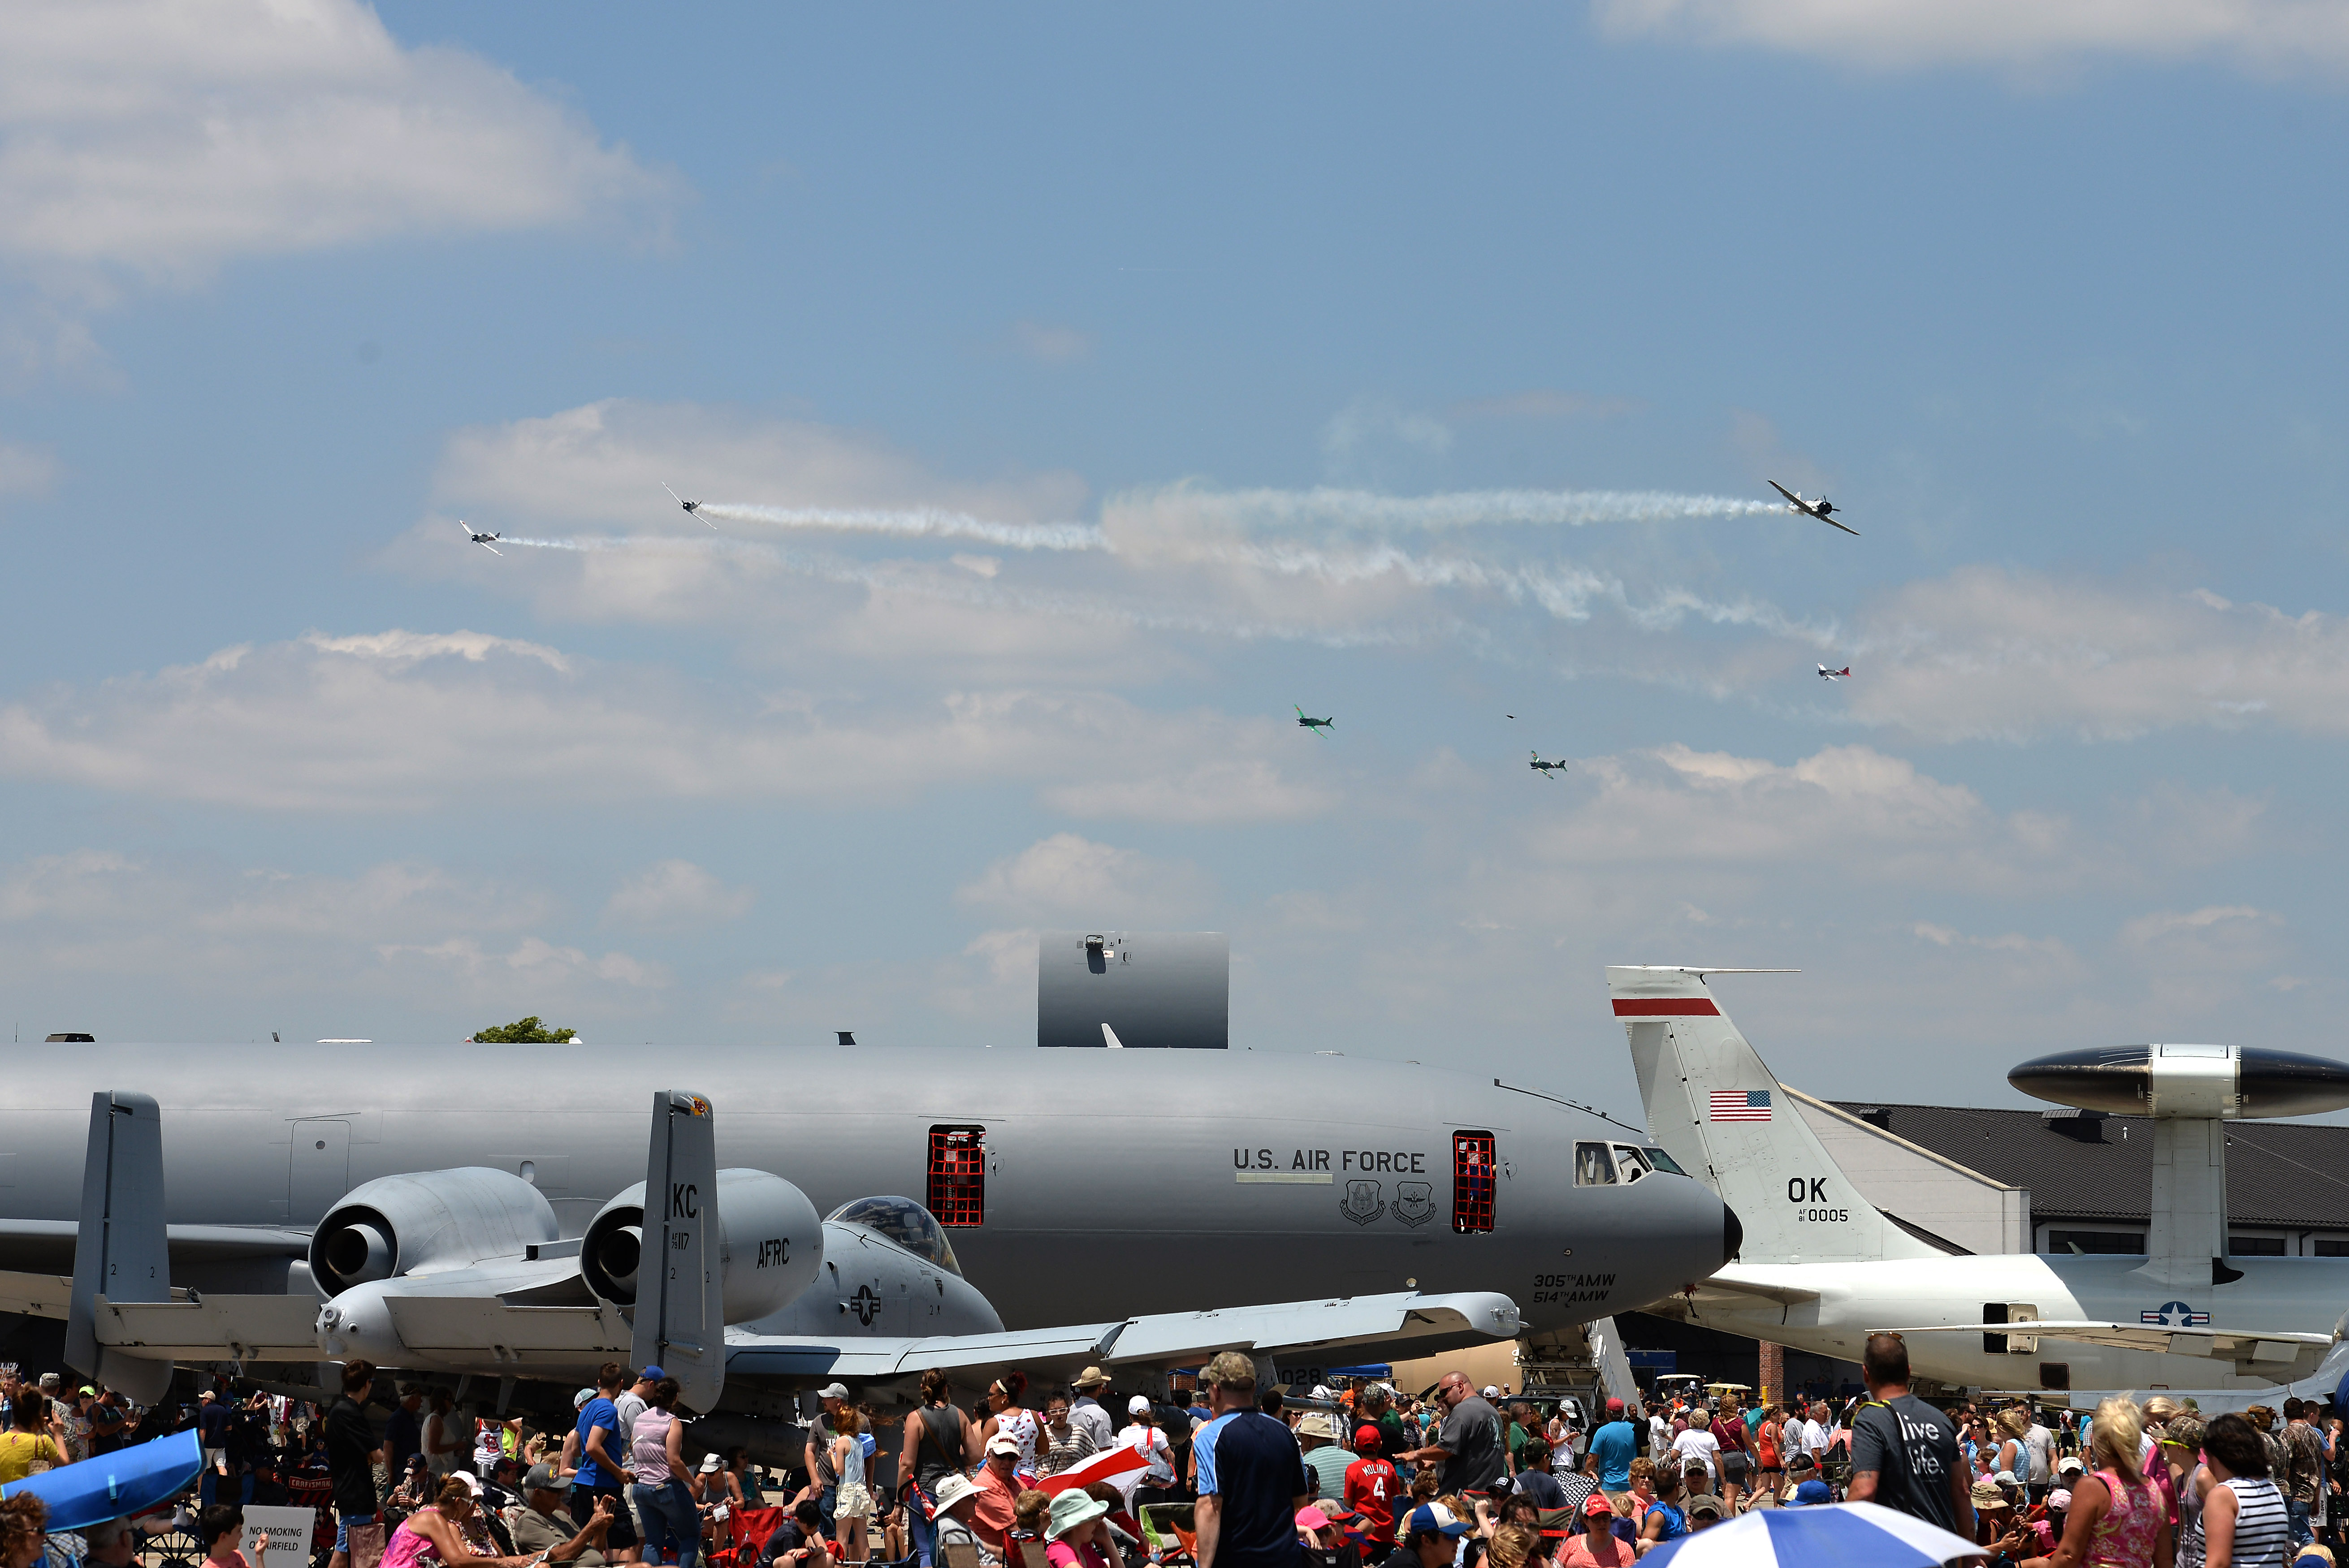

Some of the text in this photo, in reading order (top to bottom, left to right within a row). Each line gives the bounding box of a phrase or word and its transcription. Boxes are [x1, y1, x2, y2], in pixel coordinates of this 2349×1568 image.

[1234, 1149, 1425, 1173] U.S. AIR FORCE
[1788, 1177, 1828, 1202] OK
[673, 1183, 697, 1218] KC
[1349, 1212, 1363, 1223] FORCE
[1363, 1208, 1383, 1222] RESERVE
[1397, 1214, 1415, 1225] MOBILITY
[1417, 1210, 1433, 1223] COMMAND
[1808, 1209, 1848, 1222] 0005
[678, 1232, 689, 1250] 117
[757, 1238, 790, 1270] AFRC
[111, 1264, 117, 1275] 2
[150, 1266, 155, 1278] 2
[670, 1267, 676, 1279] 2
[705, 1271, 710, 1283] 2
[1575, 1274, 1616, 1287] AMW
[1568, 1290, 1609, 1302] AMW
[929, 1305, 934, 1315] 2
[1277, 1368, 1321, 1386] 028
[1896, 1412, 1940, 1441] live
[1362, 1463, 1388, 1477] MOLINA
[292, 1479, 331, 1488] CRAFTSMAN
[1373, 1476, 1385, 1501] 4
[249, 1526, 302, 1537] NO SMOKING
[249, 1541, 258, 1549] O
